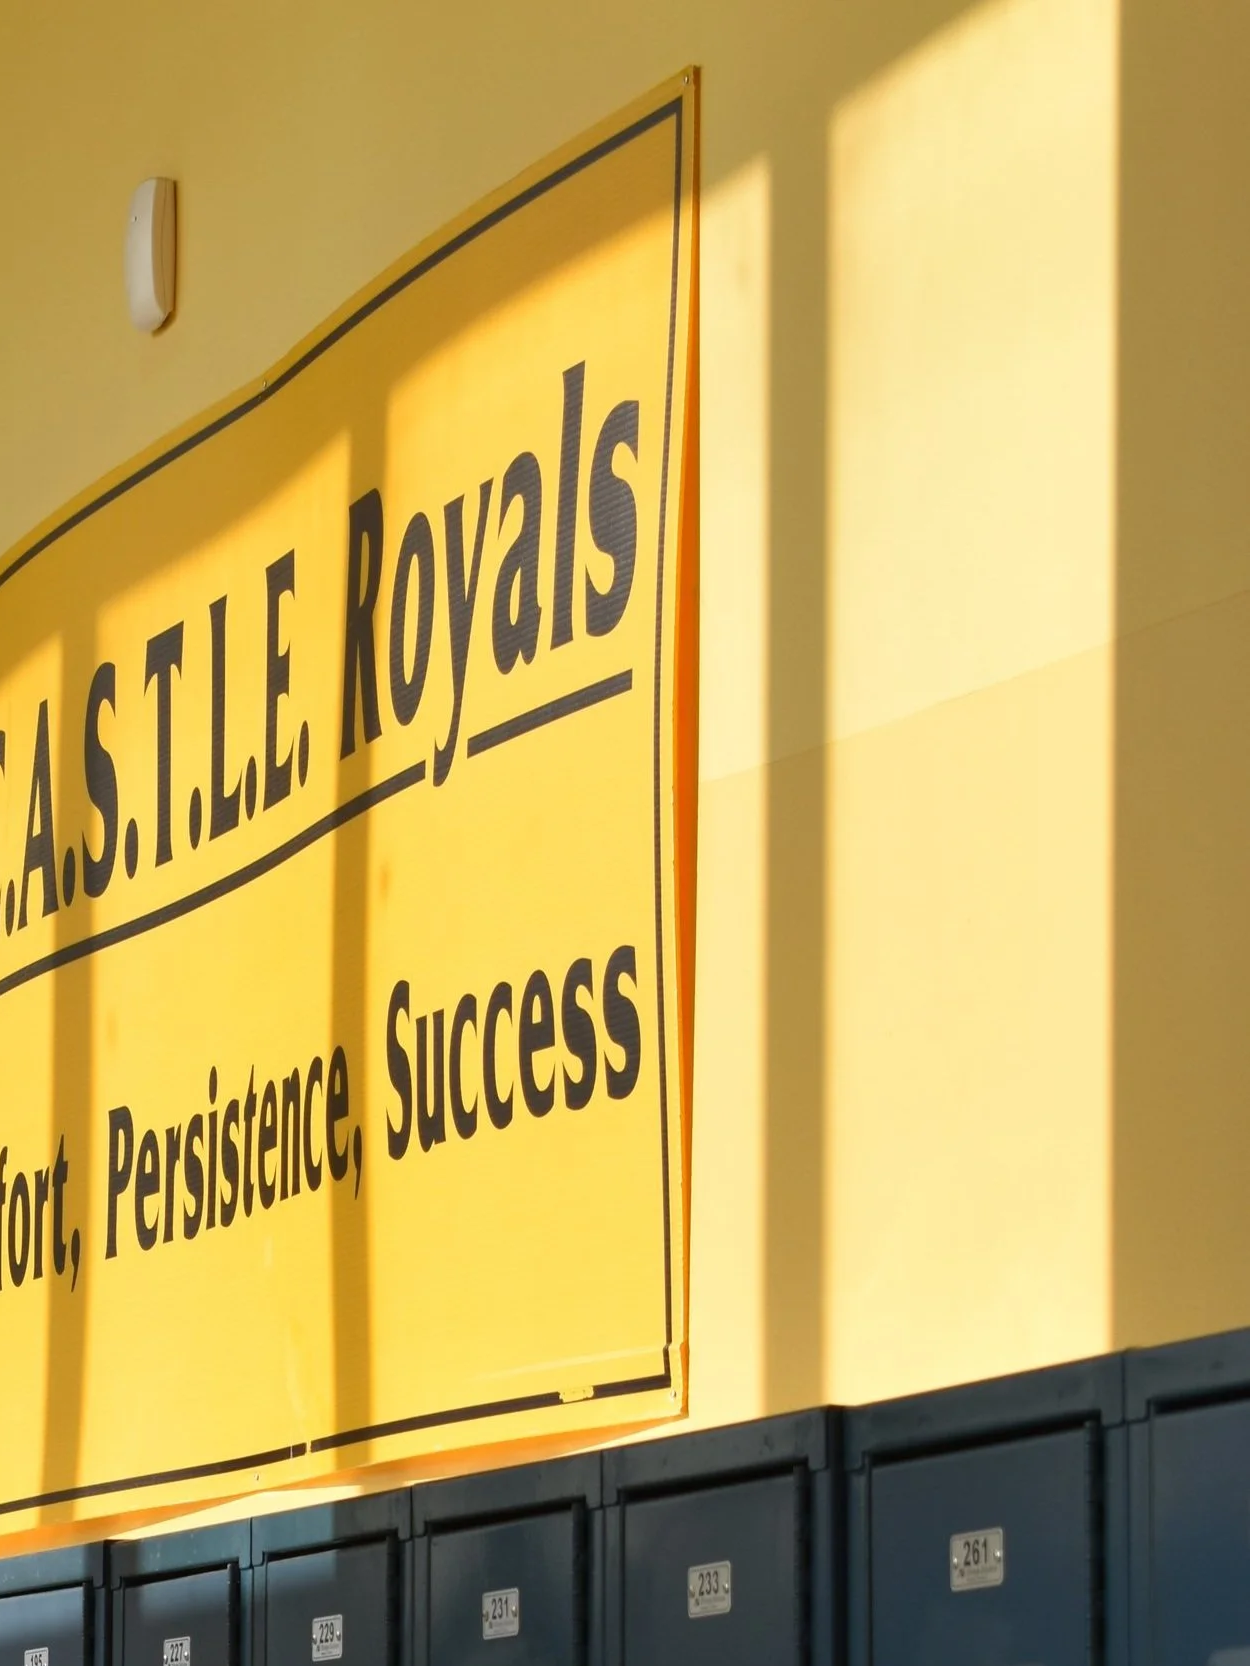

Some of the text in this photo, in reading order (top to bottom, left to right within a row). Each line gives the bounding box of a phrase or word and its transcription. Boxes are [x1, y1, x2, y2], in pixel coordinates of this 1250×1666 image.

[339, 360, 640, 788] Royals
[105, 1045, 363, 1260] Persistence,
[386, 945, 641, 1160] Success
[963, 1537, 988, 1567] 261
[698, 1570, 719, 1597] 233
[491, 1596, 510, 1620] 231
[318, 1622, 335, 1644] 229
[169, 1643, 184, 1663] 227
